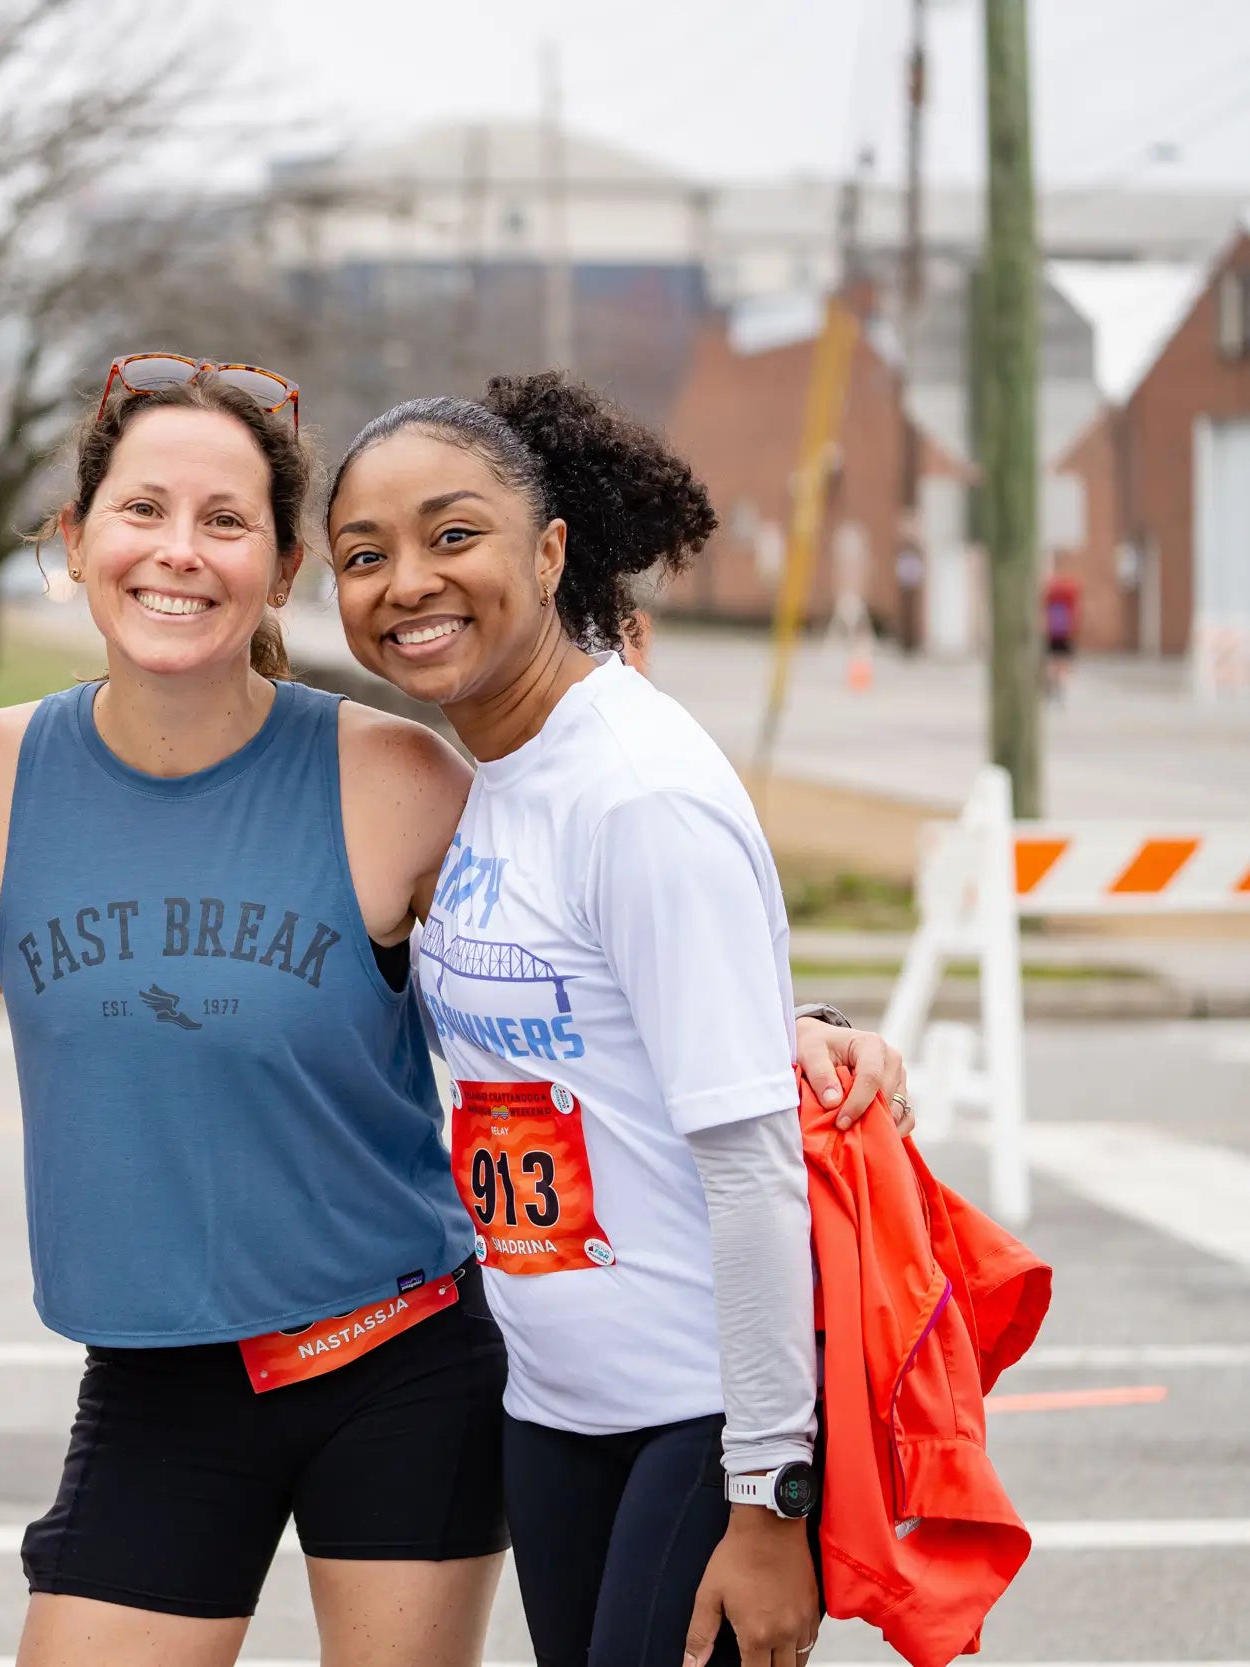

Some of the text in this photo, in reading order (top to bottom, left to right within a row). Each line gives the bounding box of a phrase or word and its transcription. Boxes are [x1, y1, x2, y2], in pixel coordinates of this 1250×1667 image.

[18, 897, 342, 995] FAST BREAK
[102, 999, 239, 1017] EST. 1977
[471, 1148, 560, 1227] 913
[297, 1298, 409, 1359] NASTASSJA
